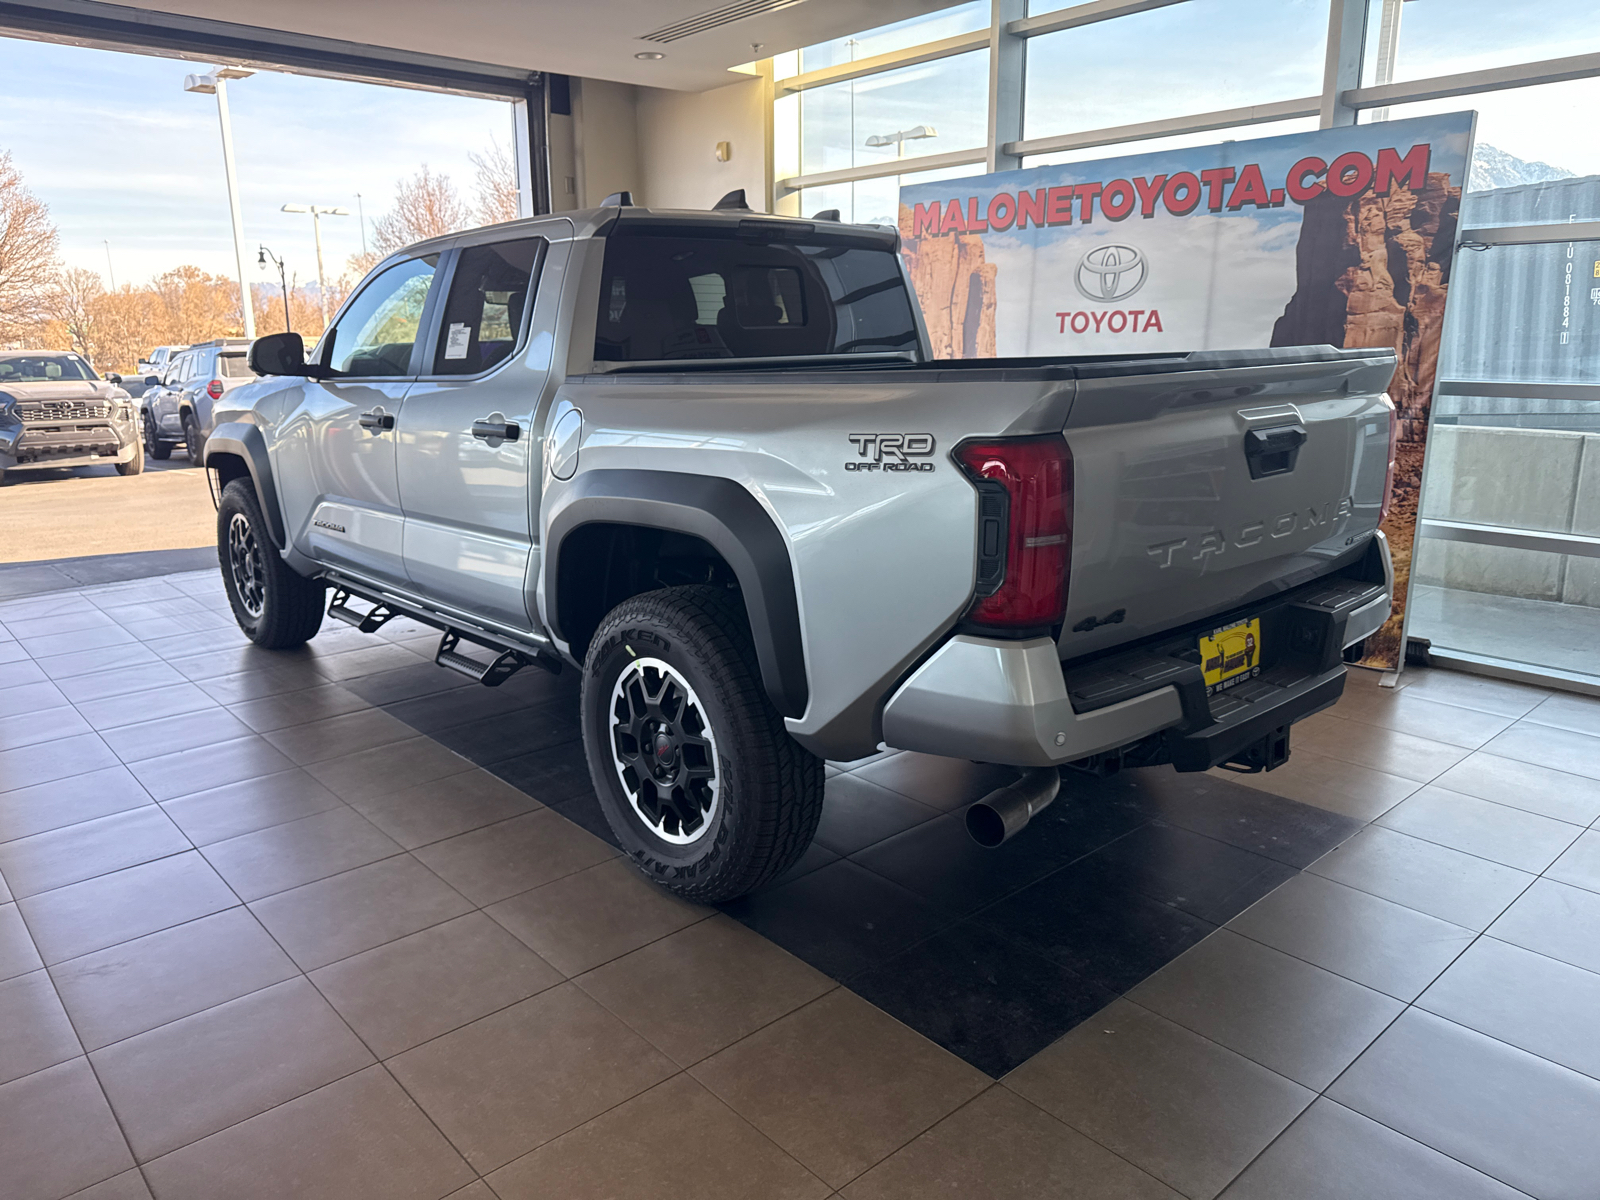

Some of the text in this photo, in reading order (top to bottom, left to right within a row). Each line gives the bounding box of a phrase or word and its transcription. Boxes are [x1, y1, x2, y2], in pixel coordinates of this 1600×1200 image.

[912, 143, 1431, 239] MALONETOYOTA.COM
[1562, 262, 1573, 328] 081884
[1055, 309, 1164, 334] TOYOTA
[845, 462, 935, 473] OFF ROAD
[848, 433, 936, 462] TRD
[1146, 496, 1354, 569] TACOMA
